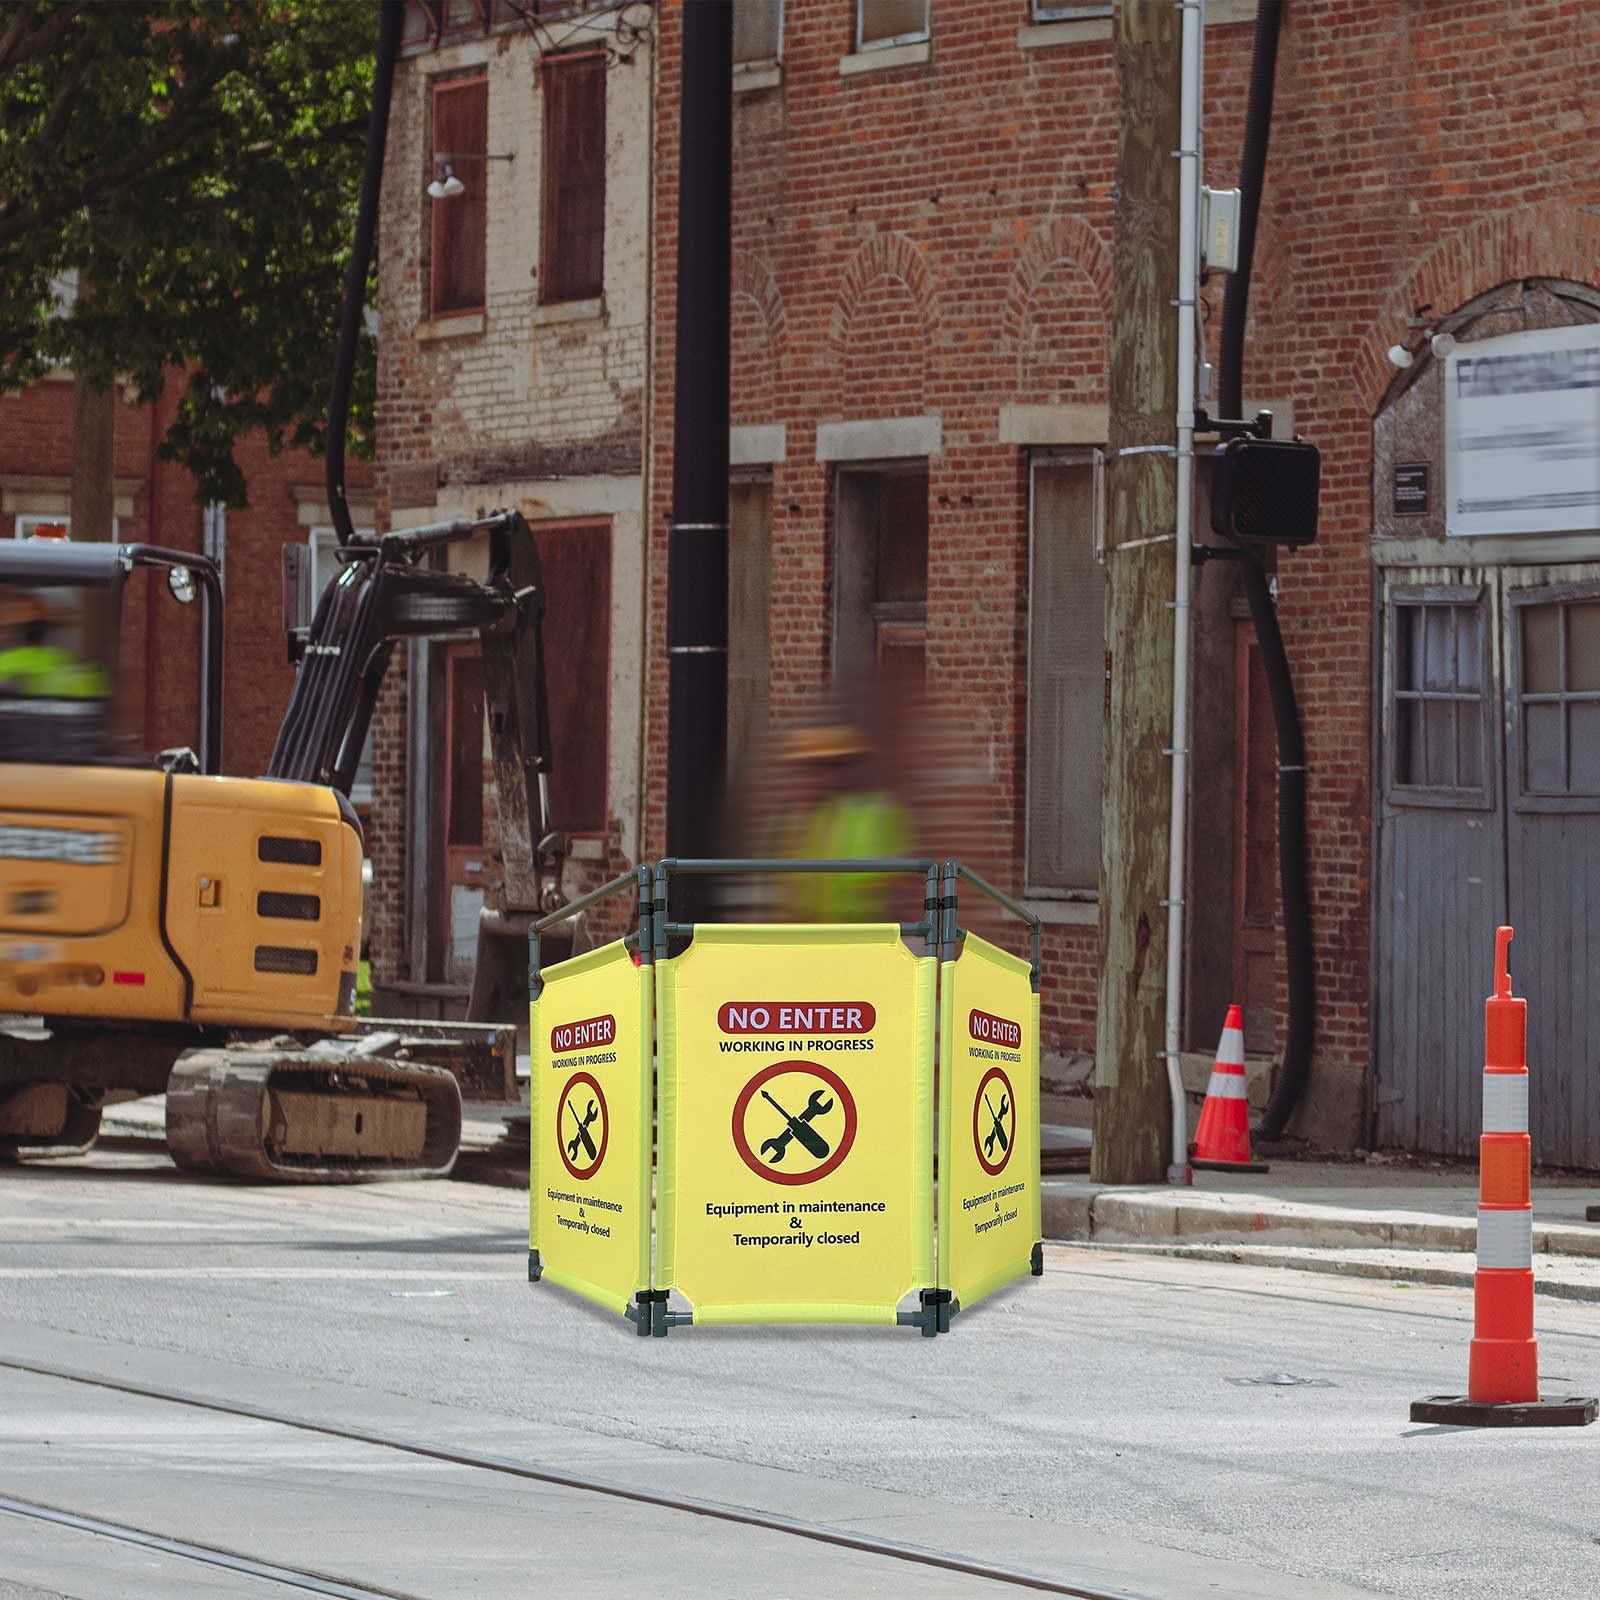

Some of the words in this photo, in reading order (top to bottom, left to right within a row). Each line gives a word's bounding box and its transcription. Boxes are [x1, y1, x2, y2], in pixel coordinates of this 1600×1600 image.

[728, 1008, 770, 1029] NO
[779, 1008, 863, 1029] ENTER
[556, 1028, 572, 1048] NO
[575, 1019, 611, 1045] ENTER
[973, 1015, 990, 1037] NO
[992, 1020, 1018, 1042] ENTER
[719, 1040, 785, 1052] WORKING
[789, 1040, 803, 1051] IN
[807, 1039, 874, 1050] PROGRESS
[969, 1047, 994, 1059] WORKING
[994, 1051, 1000, 1060] IN
[1001, 1051, 1021, 1062] PROGRESS
[552, 1057, 577, 1068] WORKING
[578, 1056, 585, 1066] IN
[586, 1052, 616, 1065] PROGRESS
[547, 1188, 575, 1202] Equipment
[576, 1193, 582, 1204] in
[583, 1196, 622, 1212] maintenance
[962, 1192, 991, 1211] Equipment
[992, 1189, 997, 1200] in
[998, 1182, 1025, 1198] maintenance
[579, 1207, 585, 1218] &
[706, 1202, 779, 1218] Equipment
[783, 1201, 795, 1213] in
[799, 1200, 886, 1213] maintenance
[994, 1202, 1000, 1212] &
[557, 1214, 590, 1234] Temporarily
[590, 1223, 610, 1237] closed
[789, 1216, 803, 1229] &
[974, 1214, 1003, 1235] Temporarily
[1003, 1207, 1018, 1221] closed
[733, 1231, 813, 1248] Temporarily
[817, 1231, 860, 1244] closed
